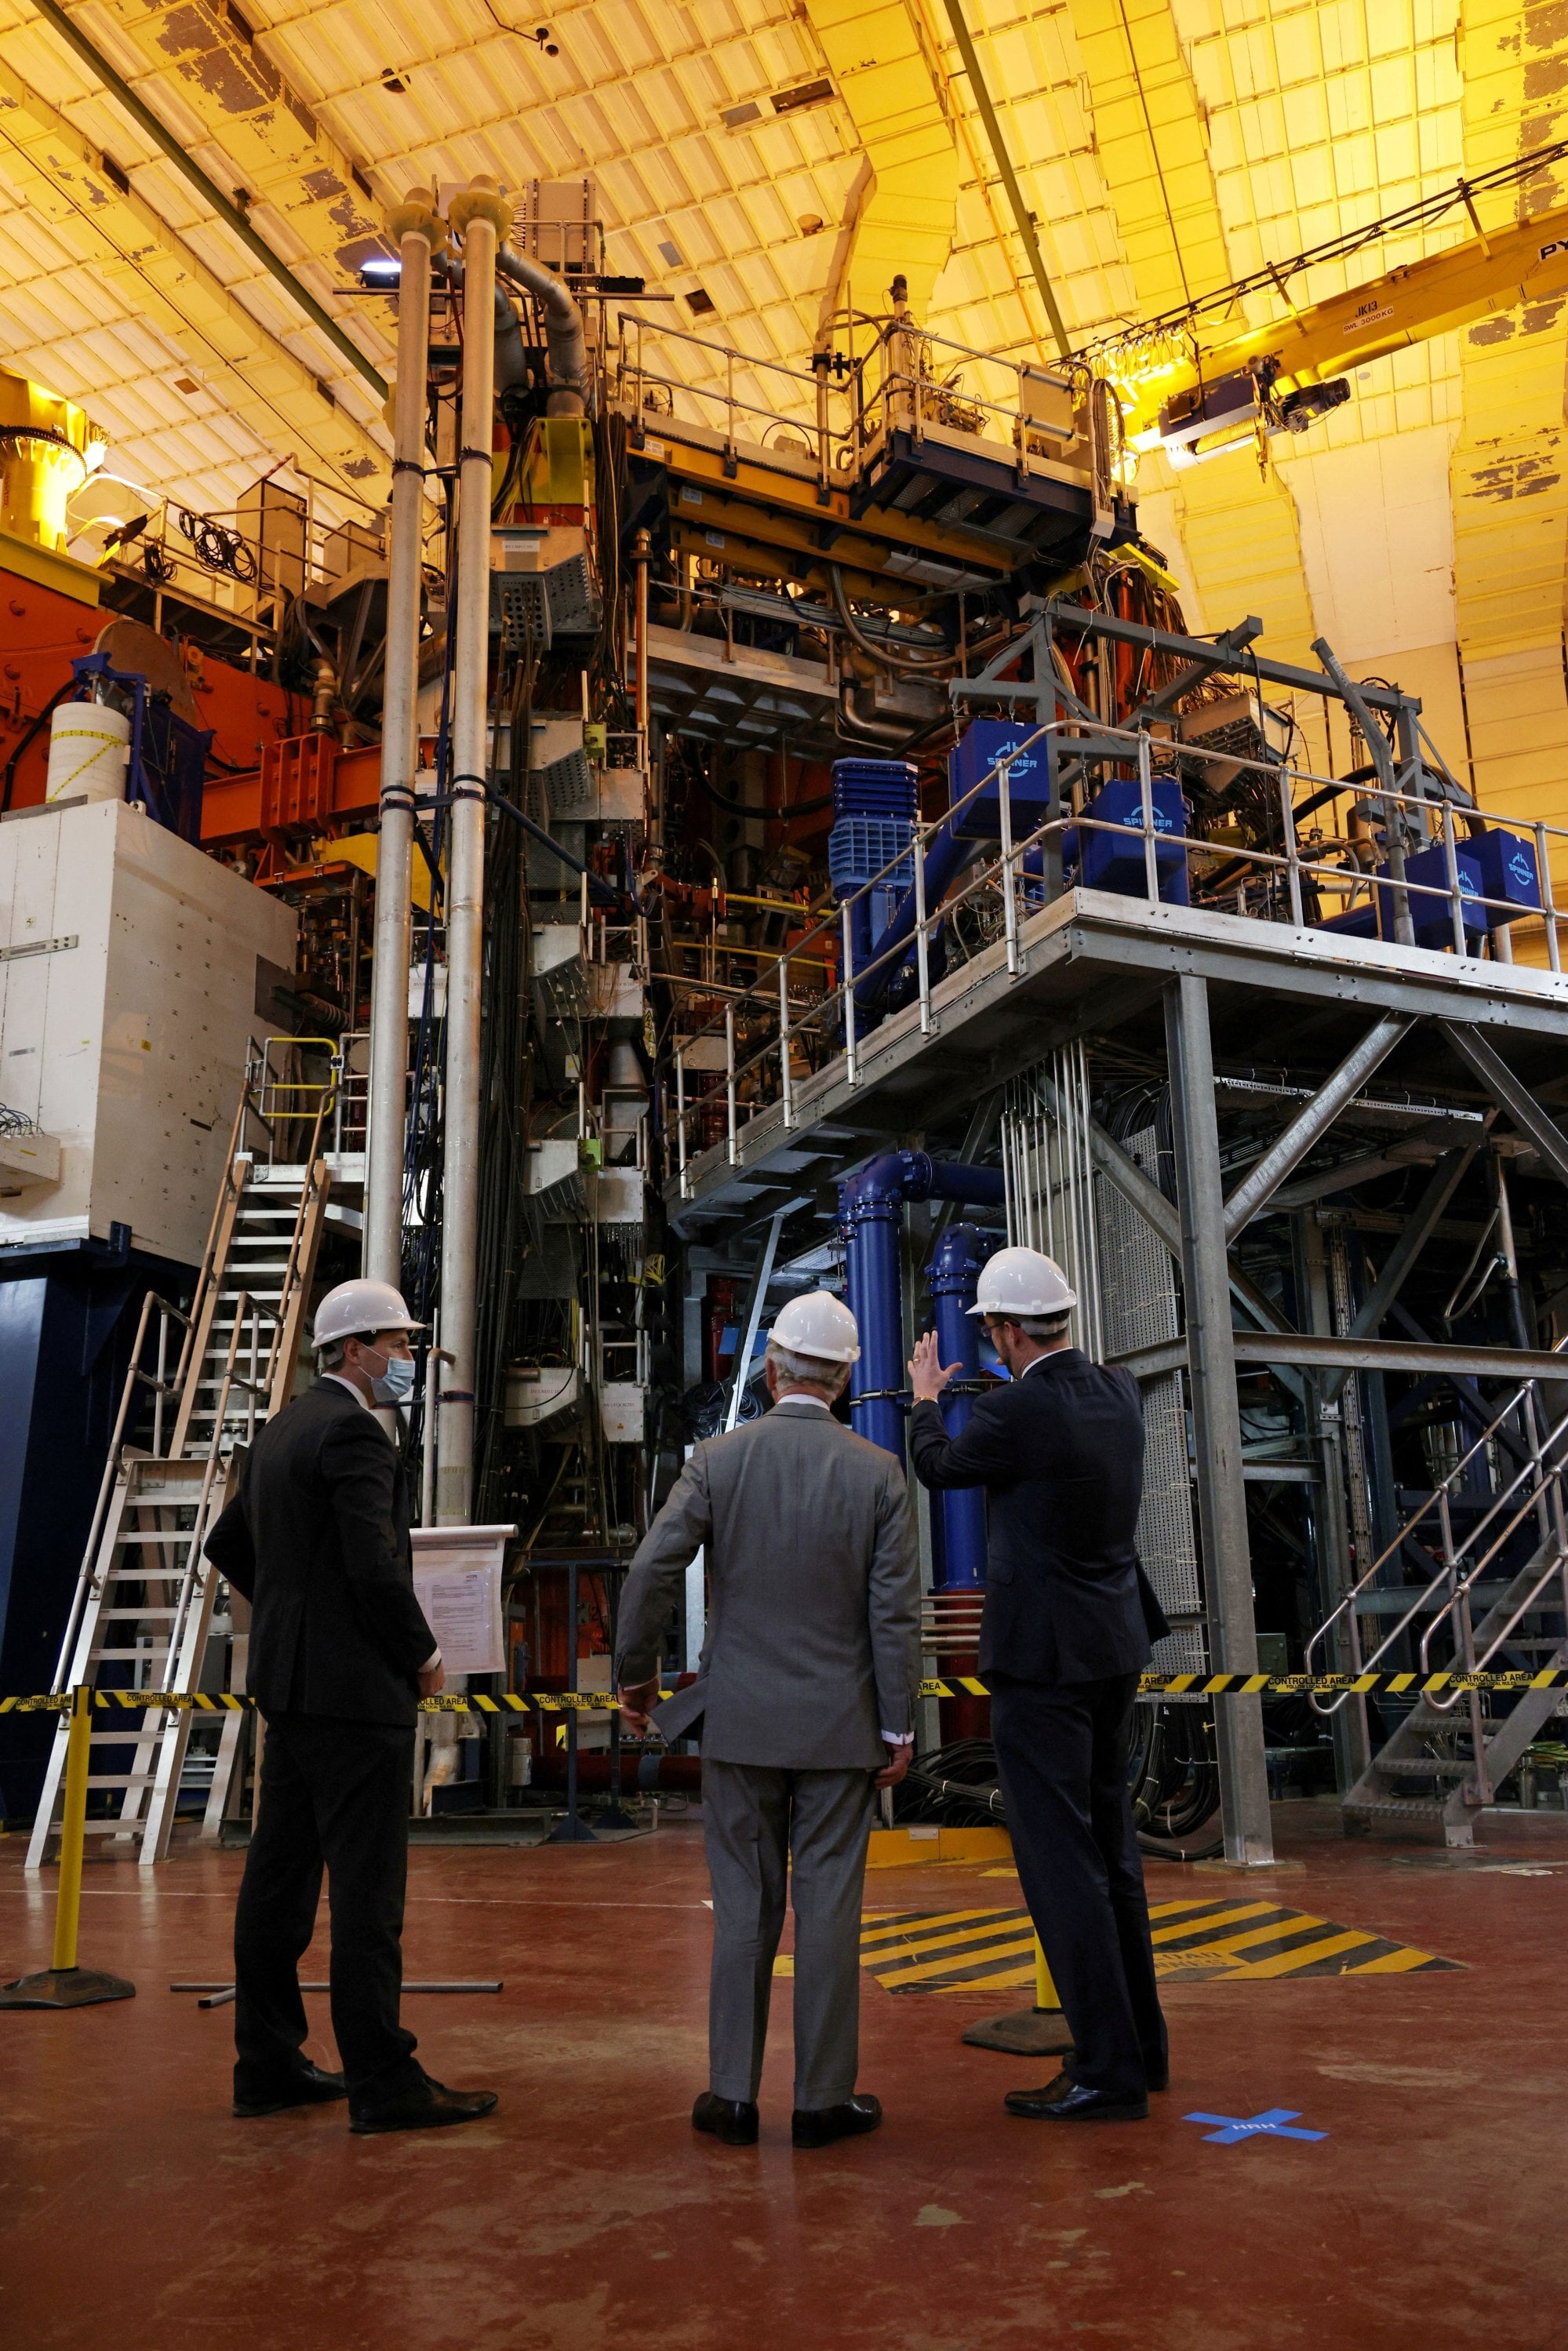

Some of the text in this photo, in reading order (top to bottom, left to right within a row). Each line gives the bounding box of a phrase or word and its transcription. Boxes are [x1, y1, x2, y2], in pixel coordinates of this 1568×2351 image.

[1355, 300, 1377, 318] JK13
[1343, 308, 1393, 332] SWL 3000KG
[987, 757, 1038, 768] SNER
[1123, 817, 1173, 827] SPINER
[1508, 863, 1533, 879] SPINNER
[1450, 1674, 1508, 1683] CONTROLLED
[16, 1697, 59, 1705] CONTROLLED
[540, 1695, 592, 1704] CONTROLLED
